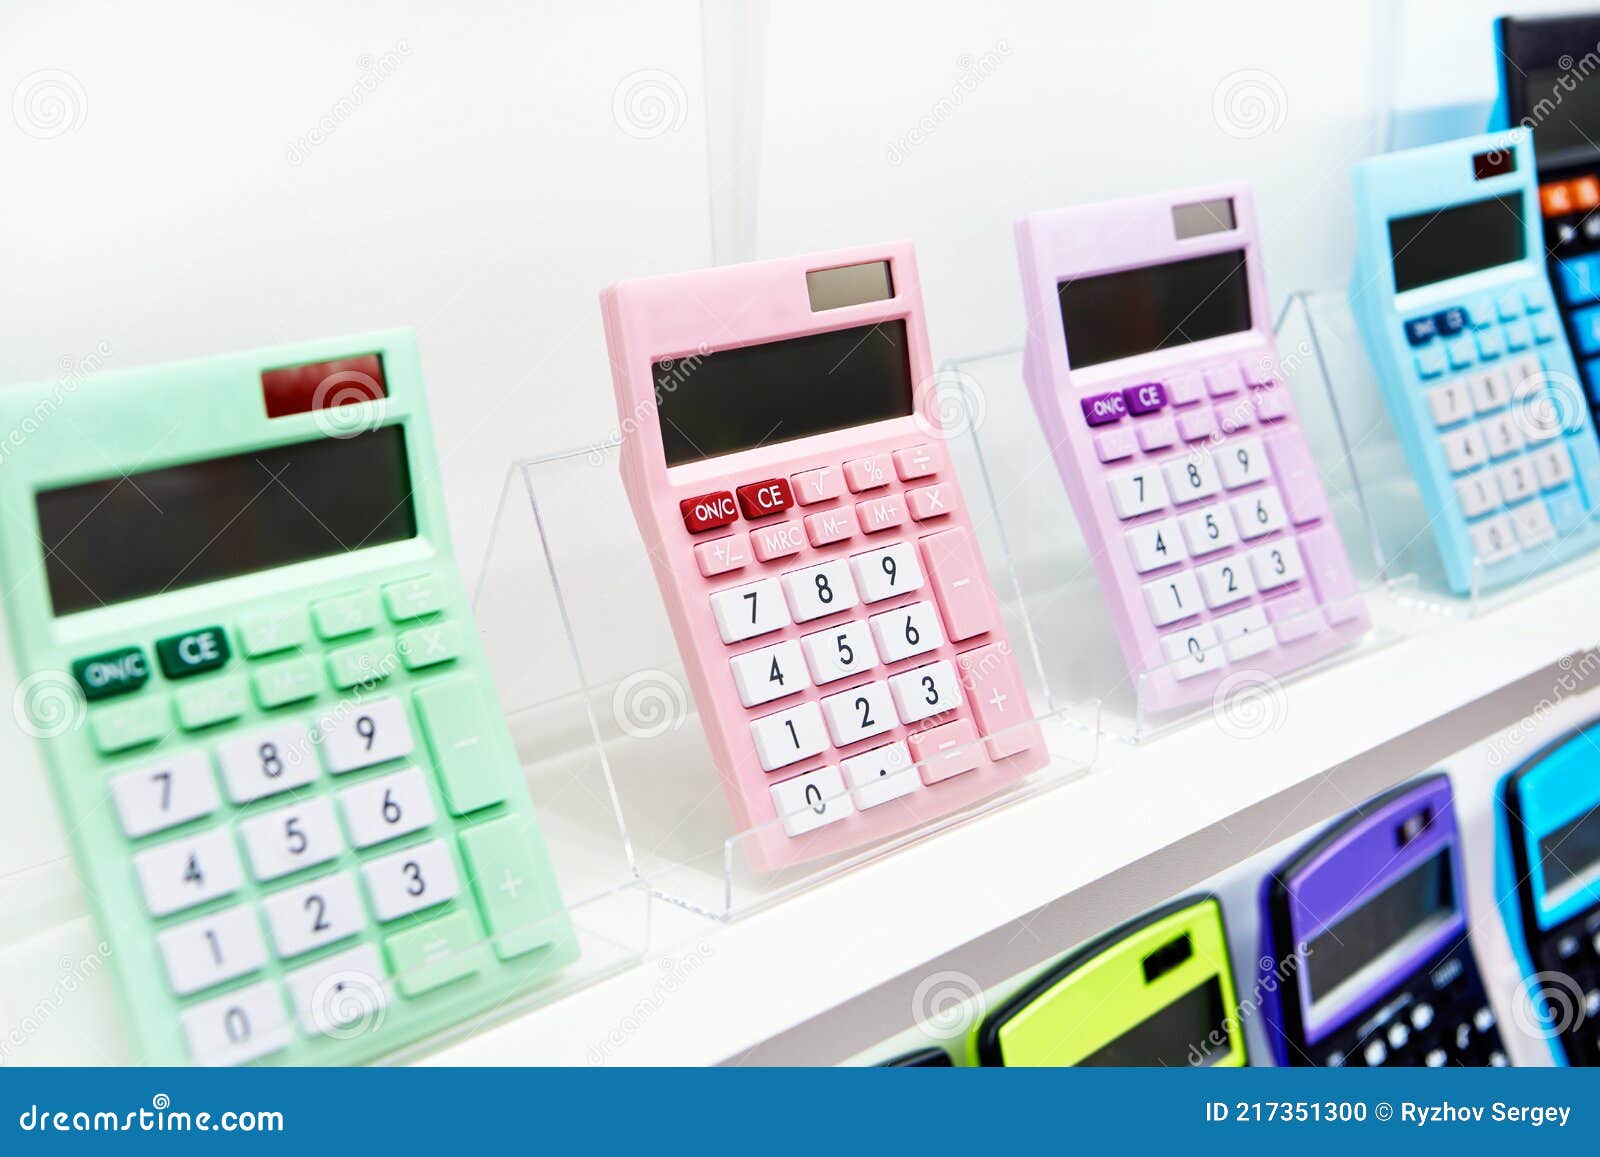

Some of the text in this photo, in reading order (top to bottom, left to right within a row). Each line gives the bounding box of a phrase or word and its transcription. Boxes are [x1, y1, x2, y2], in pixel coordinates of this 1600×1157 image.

[1094, 385, 1159, 416] ON/C CE
[1132, 448, 1249, 502] 7 8 9
[694, 496, 736, 521] ON/C
[757, 485, 784, 508] CE
[1155, 500, 1269, 555] 4 5 6
[766, 527, 803, 554] MRC
[743, 591, 758, 625] 7
[814, 573, 834, 604] 8
[881, 556, 897, 586] 9
[1169, 549, 1286, 609] 1 2 3
[178, 632, 220, 664] CE
[769, 615, 920, 686] 4 5 6
[1187, 636, 1205, 663] 0
[785, 719, 801, 749] 1
[855, 697, 875, 729] 2
[921, 675, 939, 706] 3
[151, 771, 173, 810] 7
[258, 742, 284, 779] 8
[355, 715, 376, 751] 9
[805, 783, 826, 815] 0
[182, 789, 402, 886] 4 5 6
[203, 929, 224, 966] 1
[304, 894, 331, 933] 2
[402, 861, 426, 898] 3
[224, 1005, 252, 1044] 0
